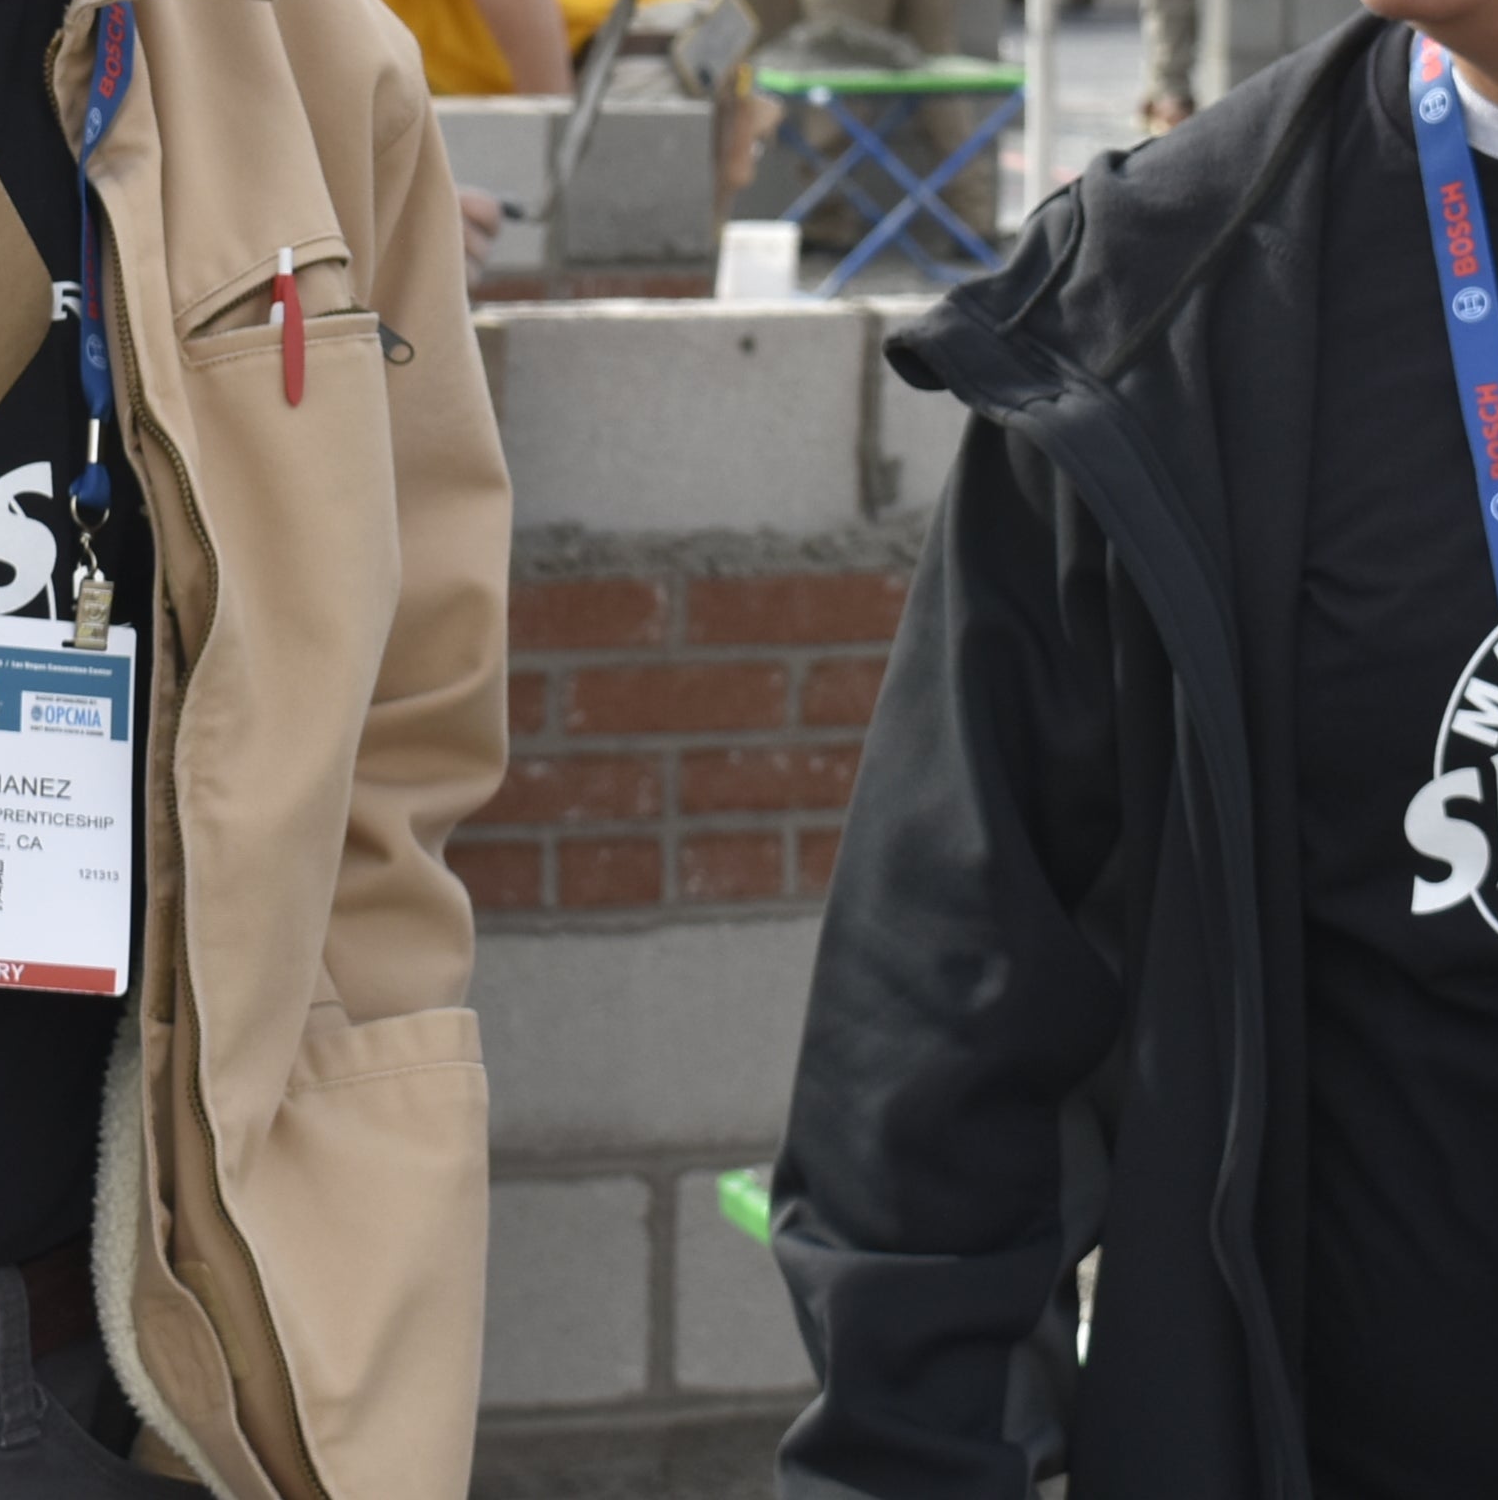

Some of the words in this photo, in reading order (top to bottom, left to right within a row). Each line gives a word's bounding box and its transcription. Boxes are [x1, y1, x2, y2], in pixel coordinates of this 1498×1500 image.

[98, 1, 127, 99] BOSCH
[1440, 181, 1478, 278] BOSCH
[44, 704, 102, 727] OPCMIA
[16, 834, 43, 851] CA
[78, 868, 119, 882] 121313
